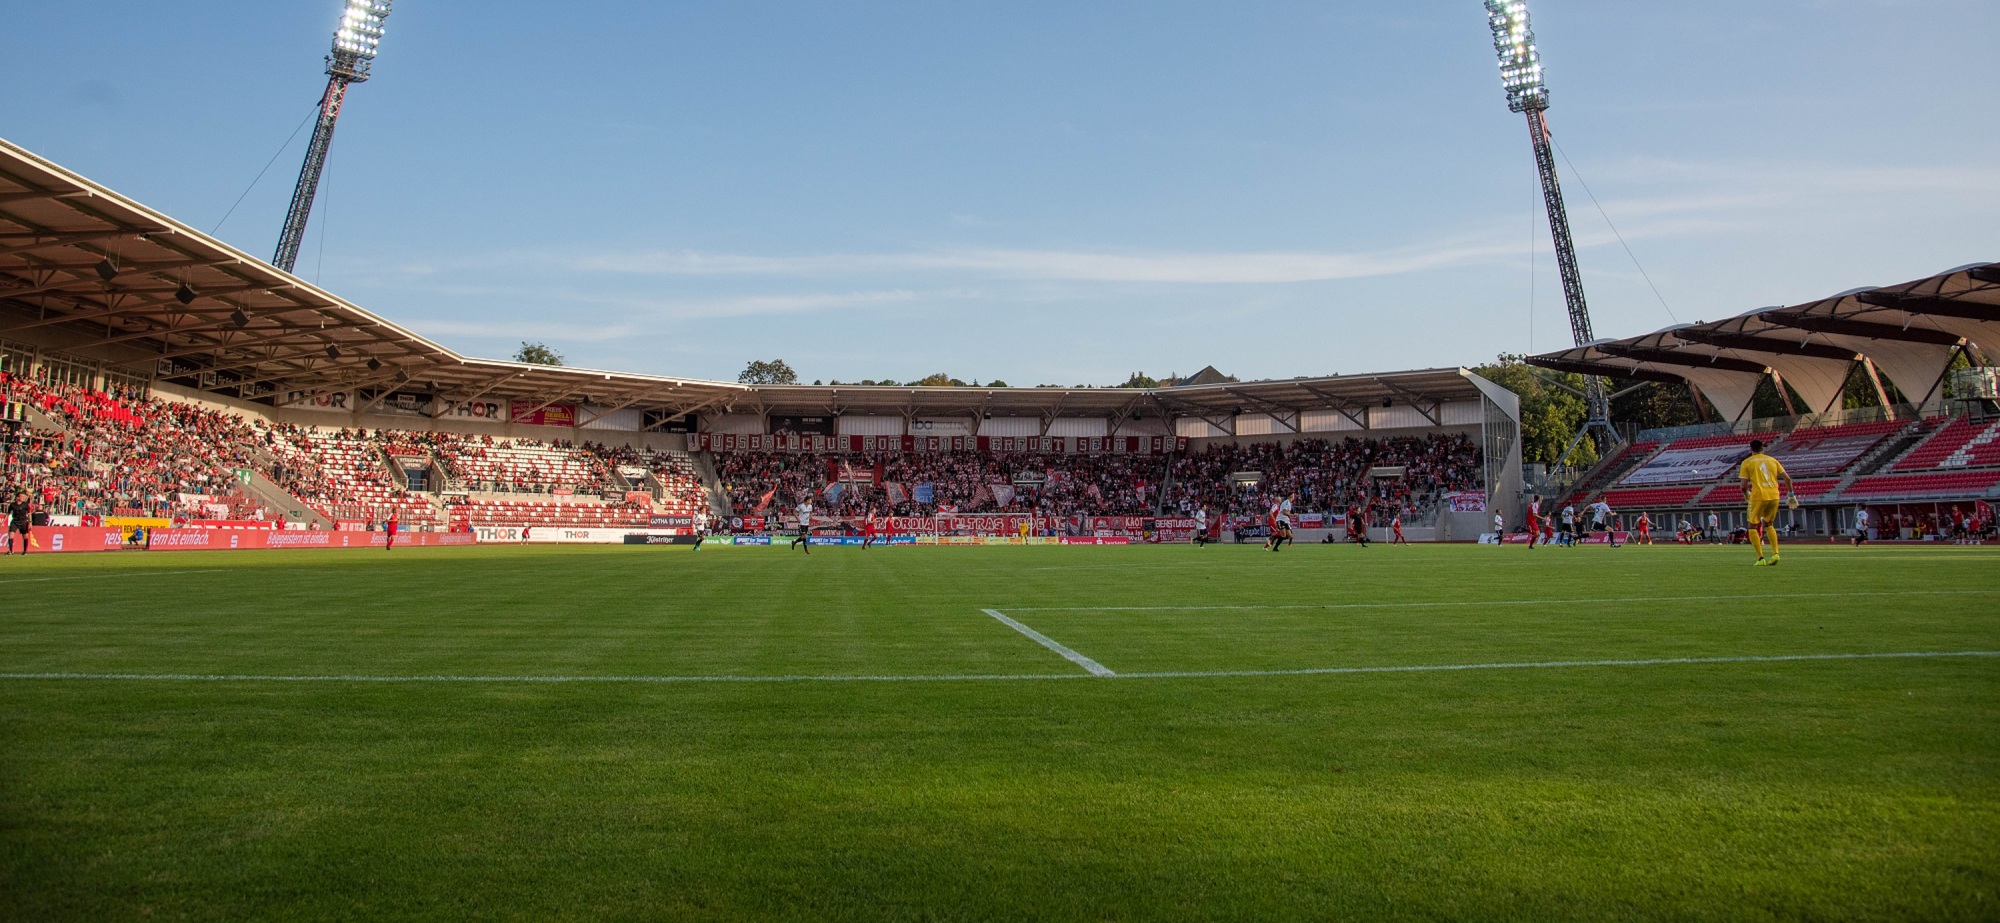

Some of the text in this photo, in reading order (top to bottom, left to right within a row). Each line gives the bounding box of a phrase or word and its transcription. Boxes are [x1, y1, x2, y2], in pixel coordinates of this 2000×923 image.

[445, 400, 499, 419] THOR
[912, 417, 933, 430] iba
[700, 435, 849, 450] FUSSBALLCLUB
[990, 437, 1065, 451] ERFURT
[1079, 438, 1126, 450] SEIT
[1142, 438, 1187, 450] 1966
[1759, 462, 1769, 480] 1
[479, 528, 517, 540] THOR
[564, 531, 590, 539] THOR
